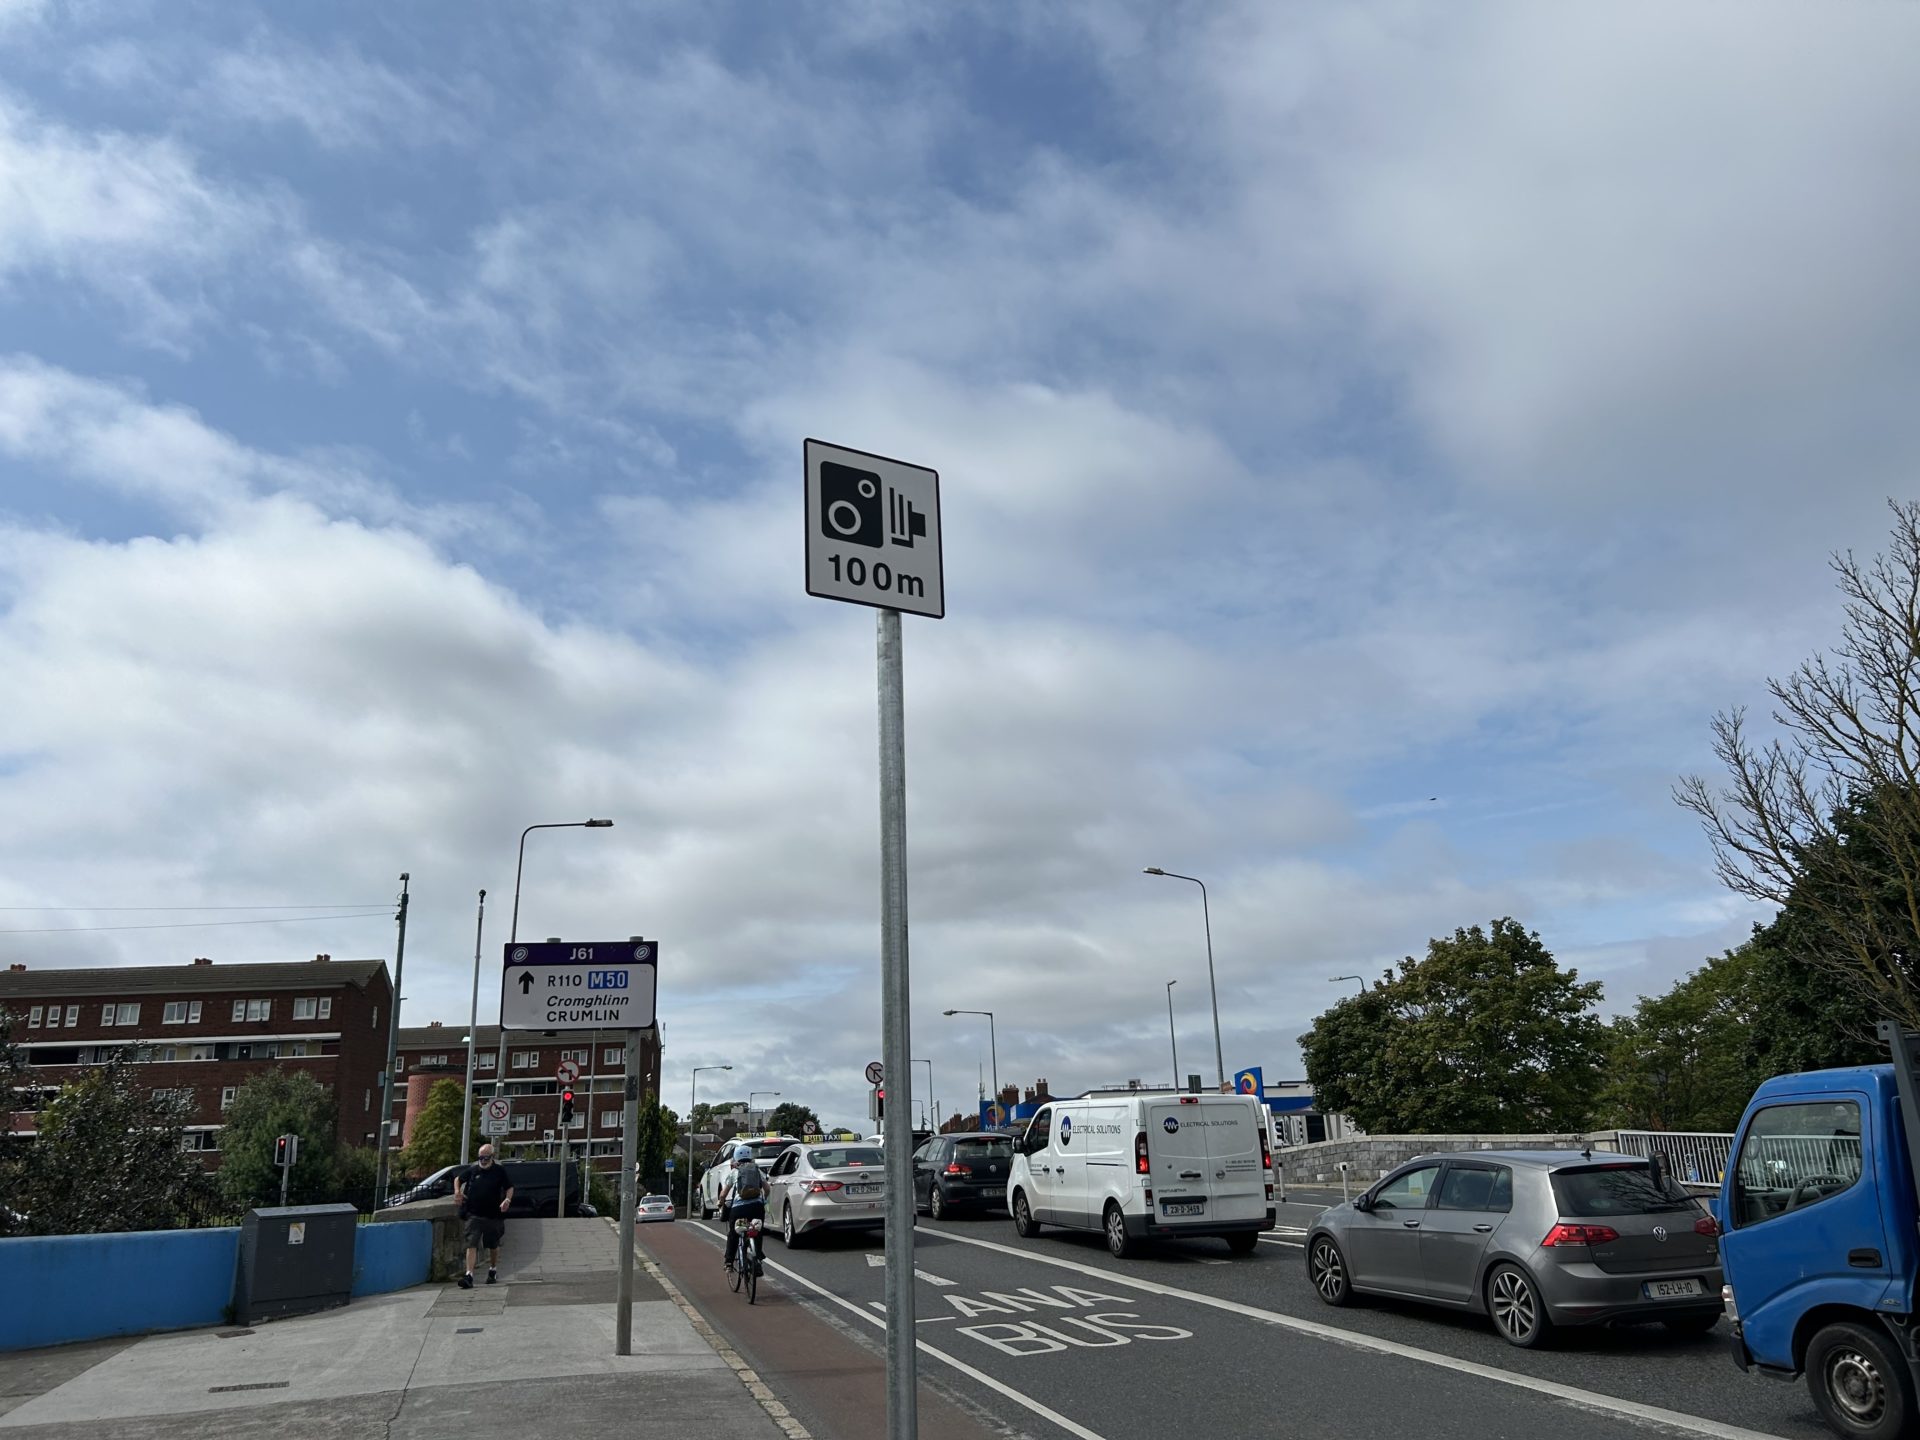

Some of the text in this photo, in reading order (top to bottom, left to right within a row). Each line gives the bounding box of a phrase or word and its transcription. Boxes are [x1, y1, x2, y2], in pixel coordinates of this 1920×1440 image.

[828, 553, 924, 597] 100m
[569, 947, 594, 960] J61
[547, 972, 627, 988] R110 M50
[547, 994, 629, 1008] Cromghlinn
[547, 1009, 620, 1023] CRUMLIN
[1072, 1124, 1121, 1134] ELECTRICAL SOLUTIONS
[1656, 1281, 1693, 1295] 152-LH-10
[955, 1312, 1194, 1357] BUS
